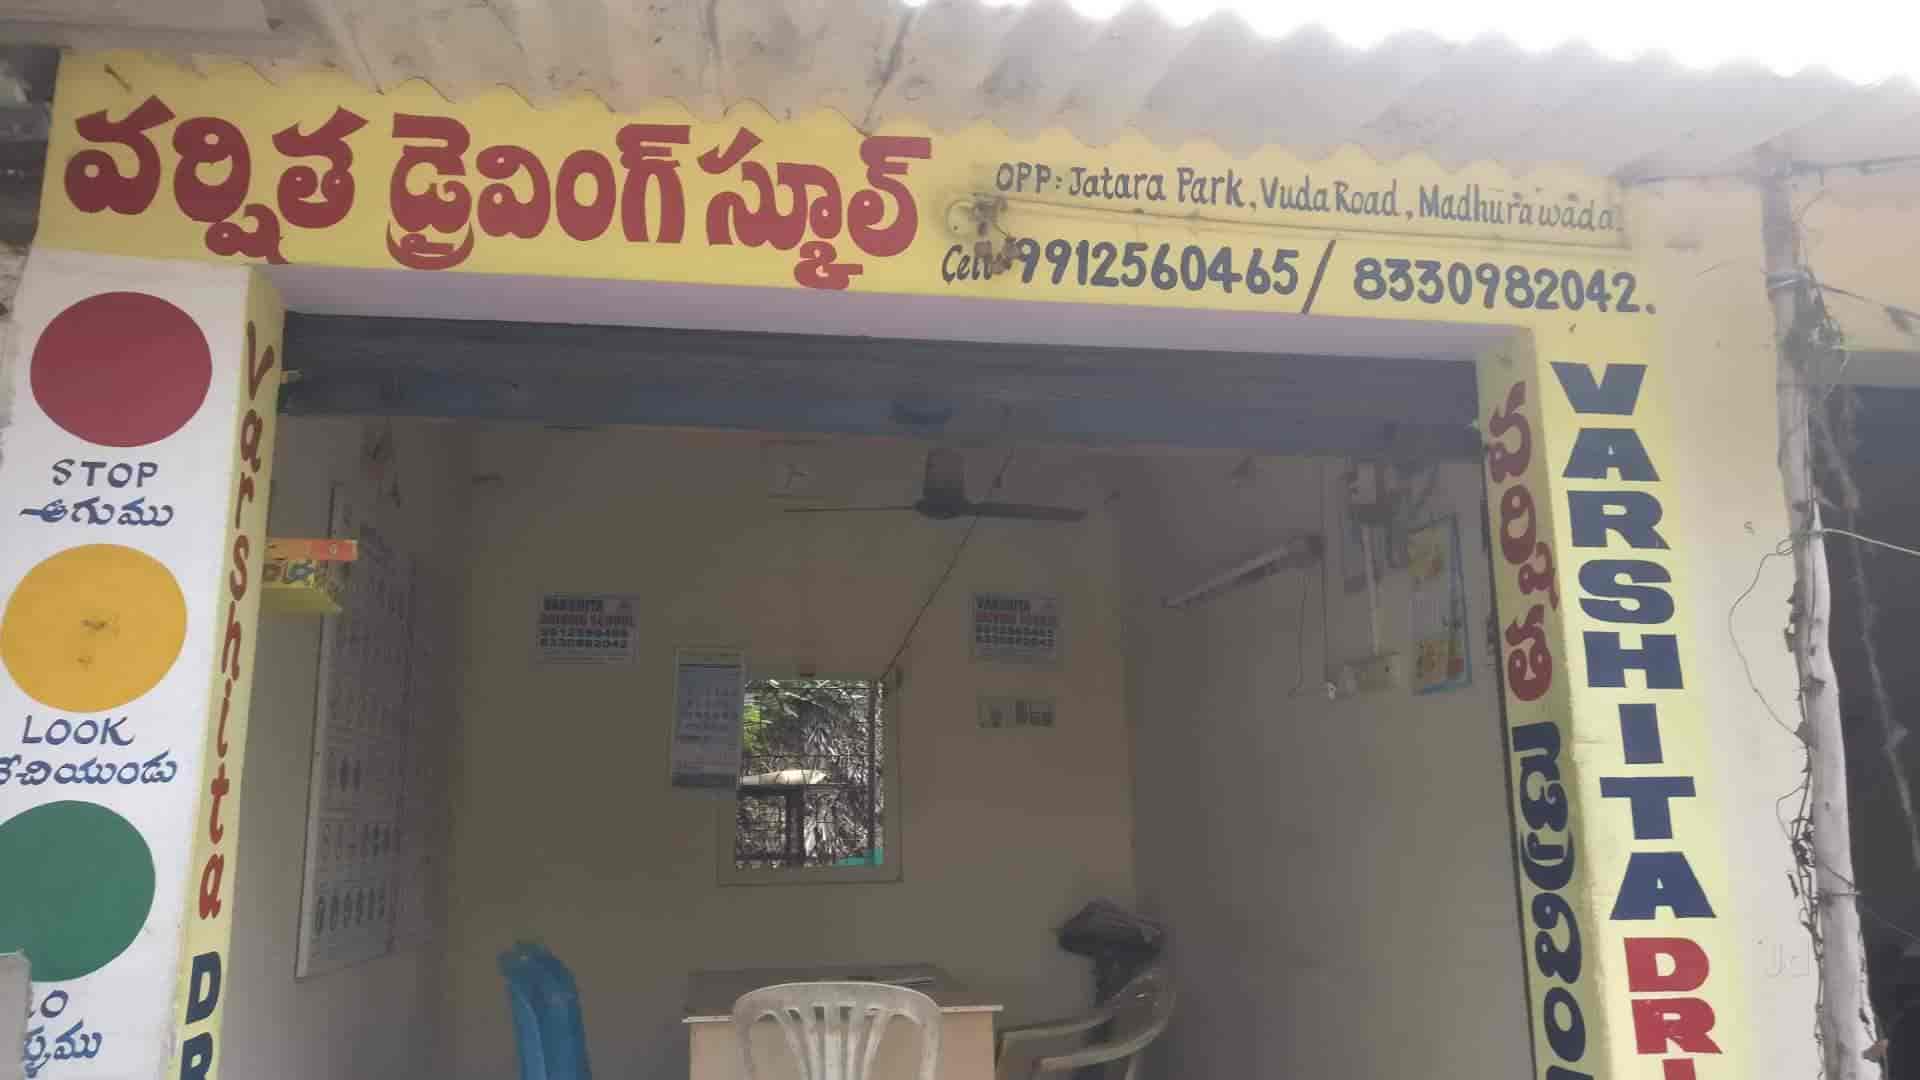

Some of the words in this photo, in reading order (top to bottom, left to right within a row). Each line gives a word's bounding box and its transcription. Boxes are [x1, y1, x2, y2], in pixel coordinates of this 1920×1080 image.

[64, 95, 369, 265] వర్షిత
[386, 113, 692, 271] డ్రైవింగ్
[697, 126, 932, 290] స్కూల్
[1068, 167, 1167, 201] Jatara
[51, 459, 158, 488] STOP
[199, 320, 275, 920] Varshita
[1550, 361, 1716, 920] VARSHITA
[21, 715, 135, 746] LOOK
[1512, 721, 1593, 1080] డ్రైవిం
